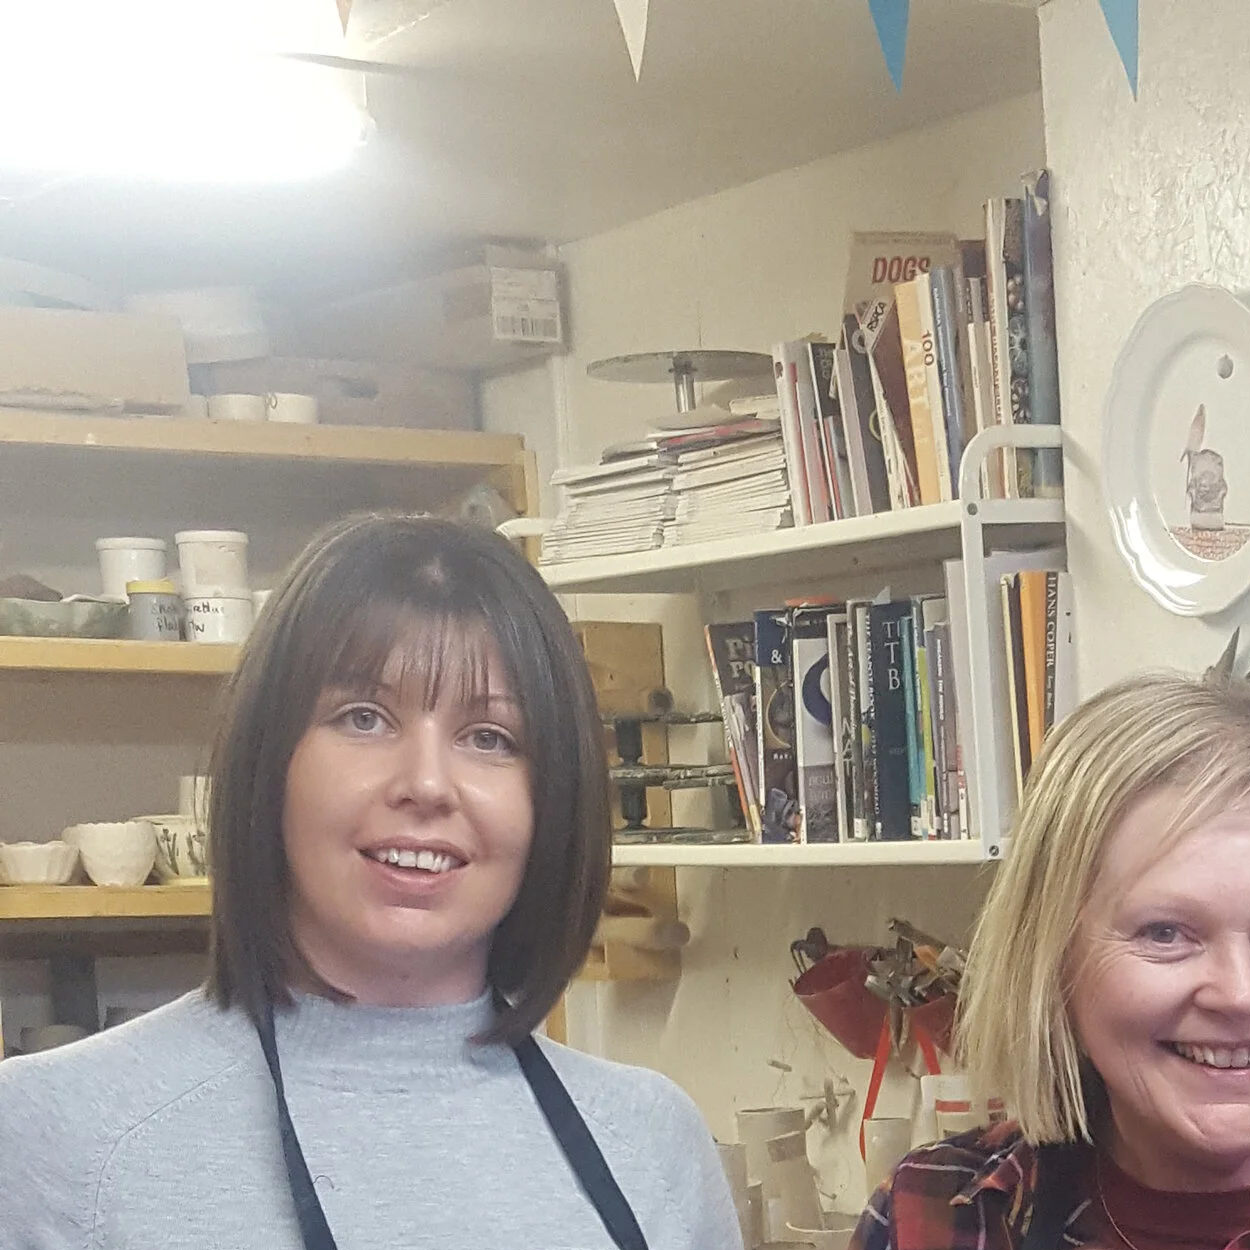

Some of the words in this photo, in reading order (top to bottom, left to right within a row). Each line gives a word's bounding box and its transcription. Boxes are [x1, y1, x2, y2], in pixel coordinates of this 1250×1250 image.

[872, 256, 931, 284] DOGS
[866, 302, 887, 333] RSPCA
[922, 330, 935, 366] 100
[1046, 576, 1057, 617] HANS
[1046, 621, 1056, 667] COPER
